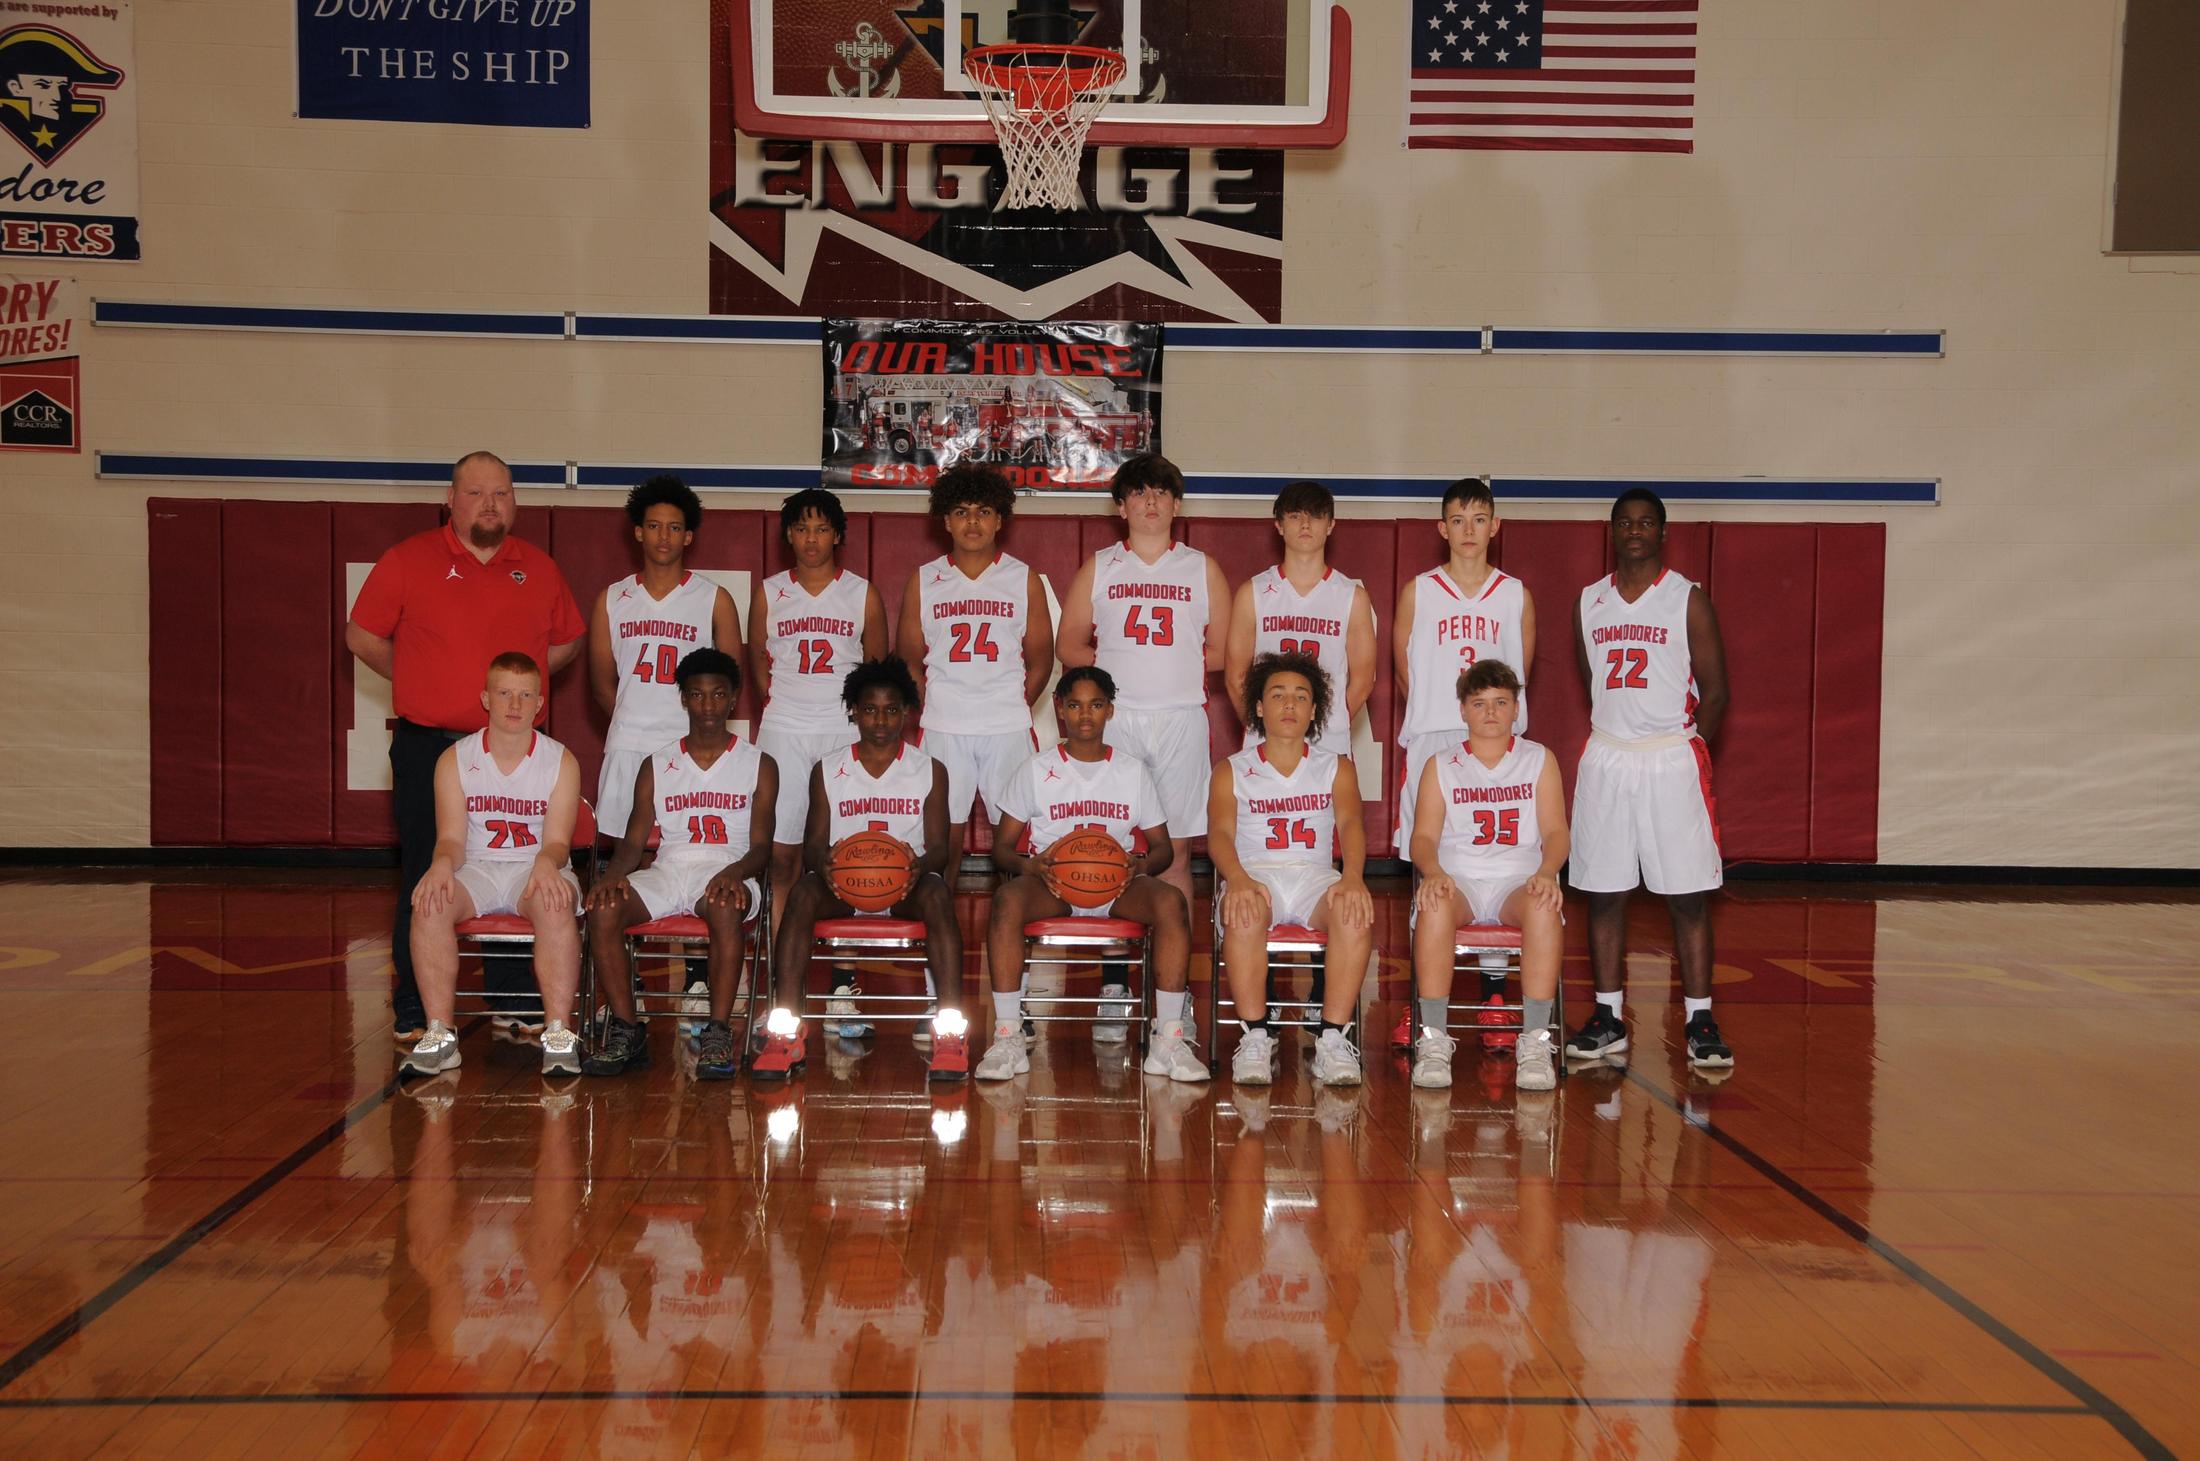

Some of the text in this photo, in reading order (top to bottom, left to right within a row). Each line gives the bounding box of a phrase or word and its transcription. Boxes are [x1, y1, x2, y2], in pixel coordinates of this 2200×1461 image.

[7, 1, 29, 12] are
[32, 3, 100, 18] supported
[102, 5, 118, 21] by
[428, 0, 519, 24] GIVE
[530, 0, 577, 27] UP
[341, 46, 570, 85] THE SHIP
[0, 163, 106, 205] dore
[2, 221, 115, 256] ERS
[970, 343, 1142, 377] HOUSE
[1108, 583, 1191, 602] COMMODORES
[933, 599, 1014, 619] COMMODORES
[620, 620, 697, 642] COMMODORES
[777, 616, 854, 637] COMMODORES
[1124, 605, 1174, 646] 43
[1263, 615, 1341, 636] COMMODORES
[1438, 615, 1499, 645] PERRY
[1592, 624, 1668, 646] COMMODORES
[949, 622, 999, 662] 24
[632, 643, 678, 684] 40
[798, 639, 834, 674] 12
[1606, 648, 1648, 689] 22
[665, 791, 747, 812] COMMODORES
[1249, 793, 1331, 814] COMMODORES
[1453, 783, 1533, 804] COMMODORES
[467, 795, 547, 816] COMMODORES
[839, 797, 920, 817] COMMODORES
[1049, 800, 1130, 820] COMMODORES
[688, 815, 728, 844] 10
[1266, 818, 1316, 849] 34
[1472, 808, 1519, 846] 35
[846, 877, 893, 888] OHSAA
[1071, 871, 1116, 883] OHSAA
